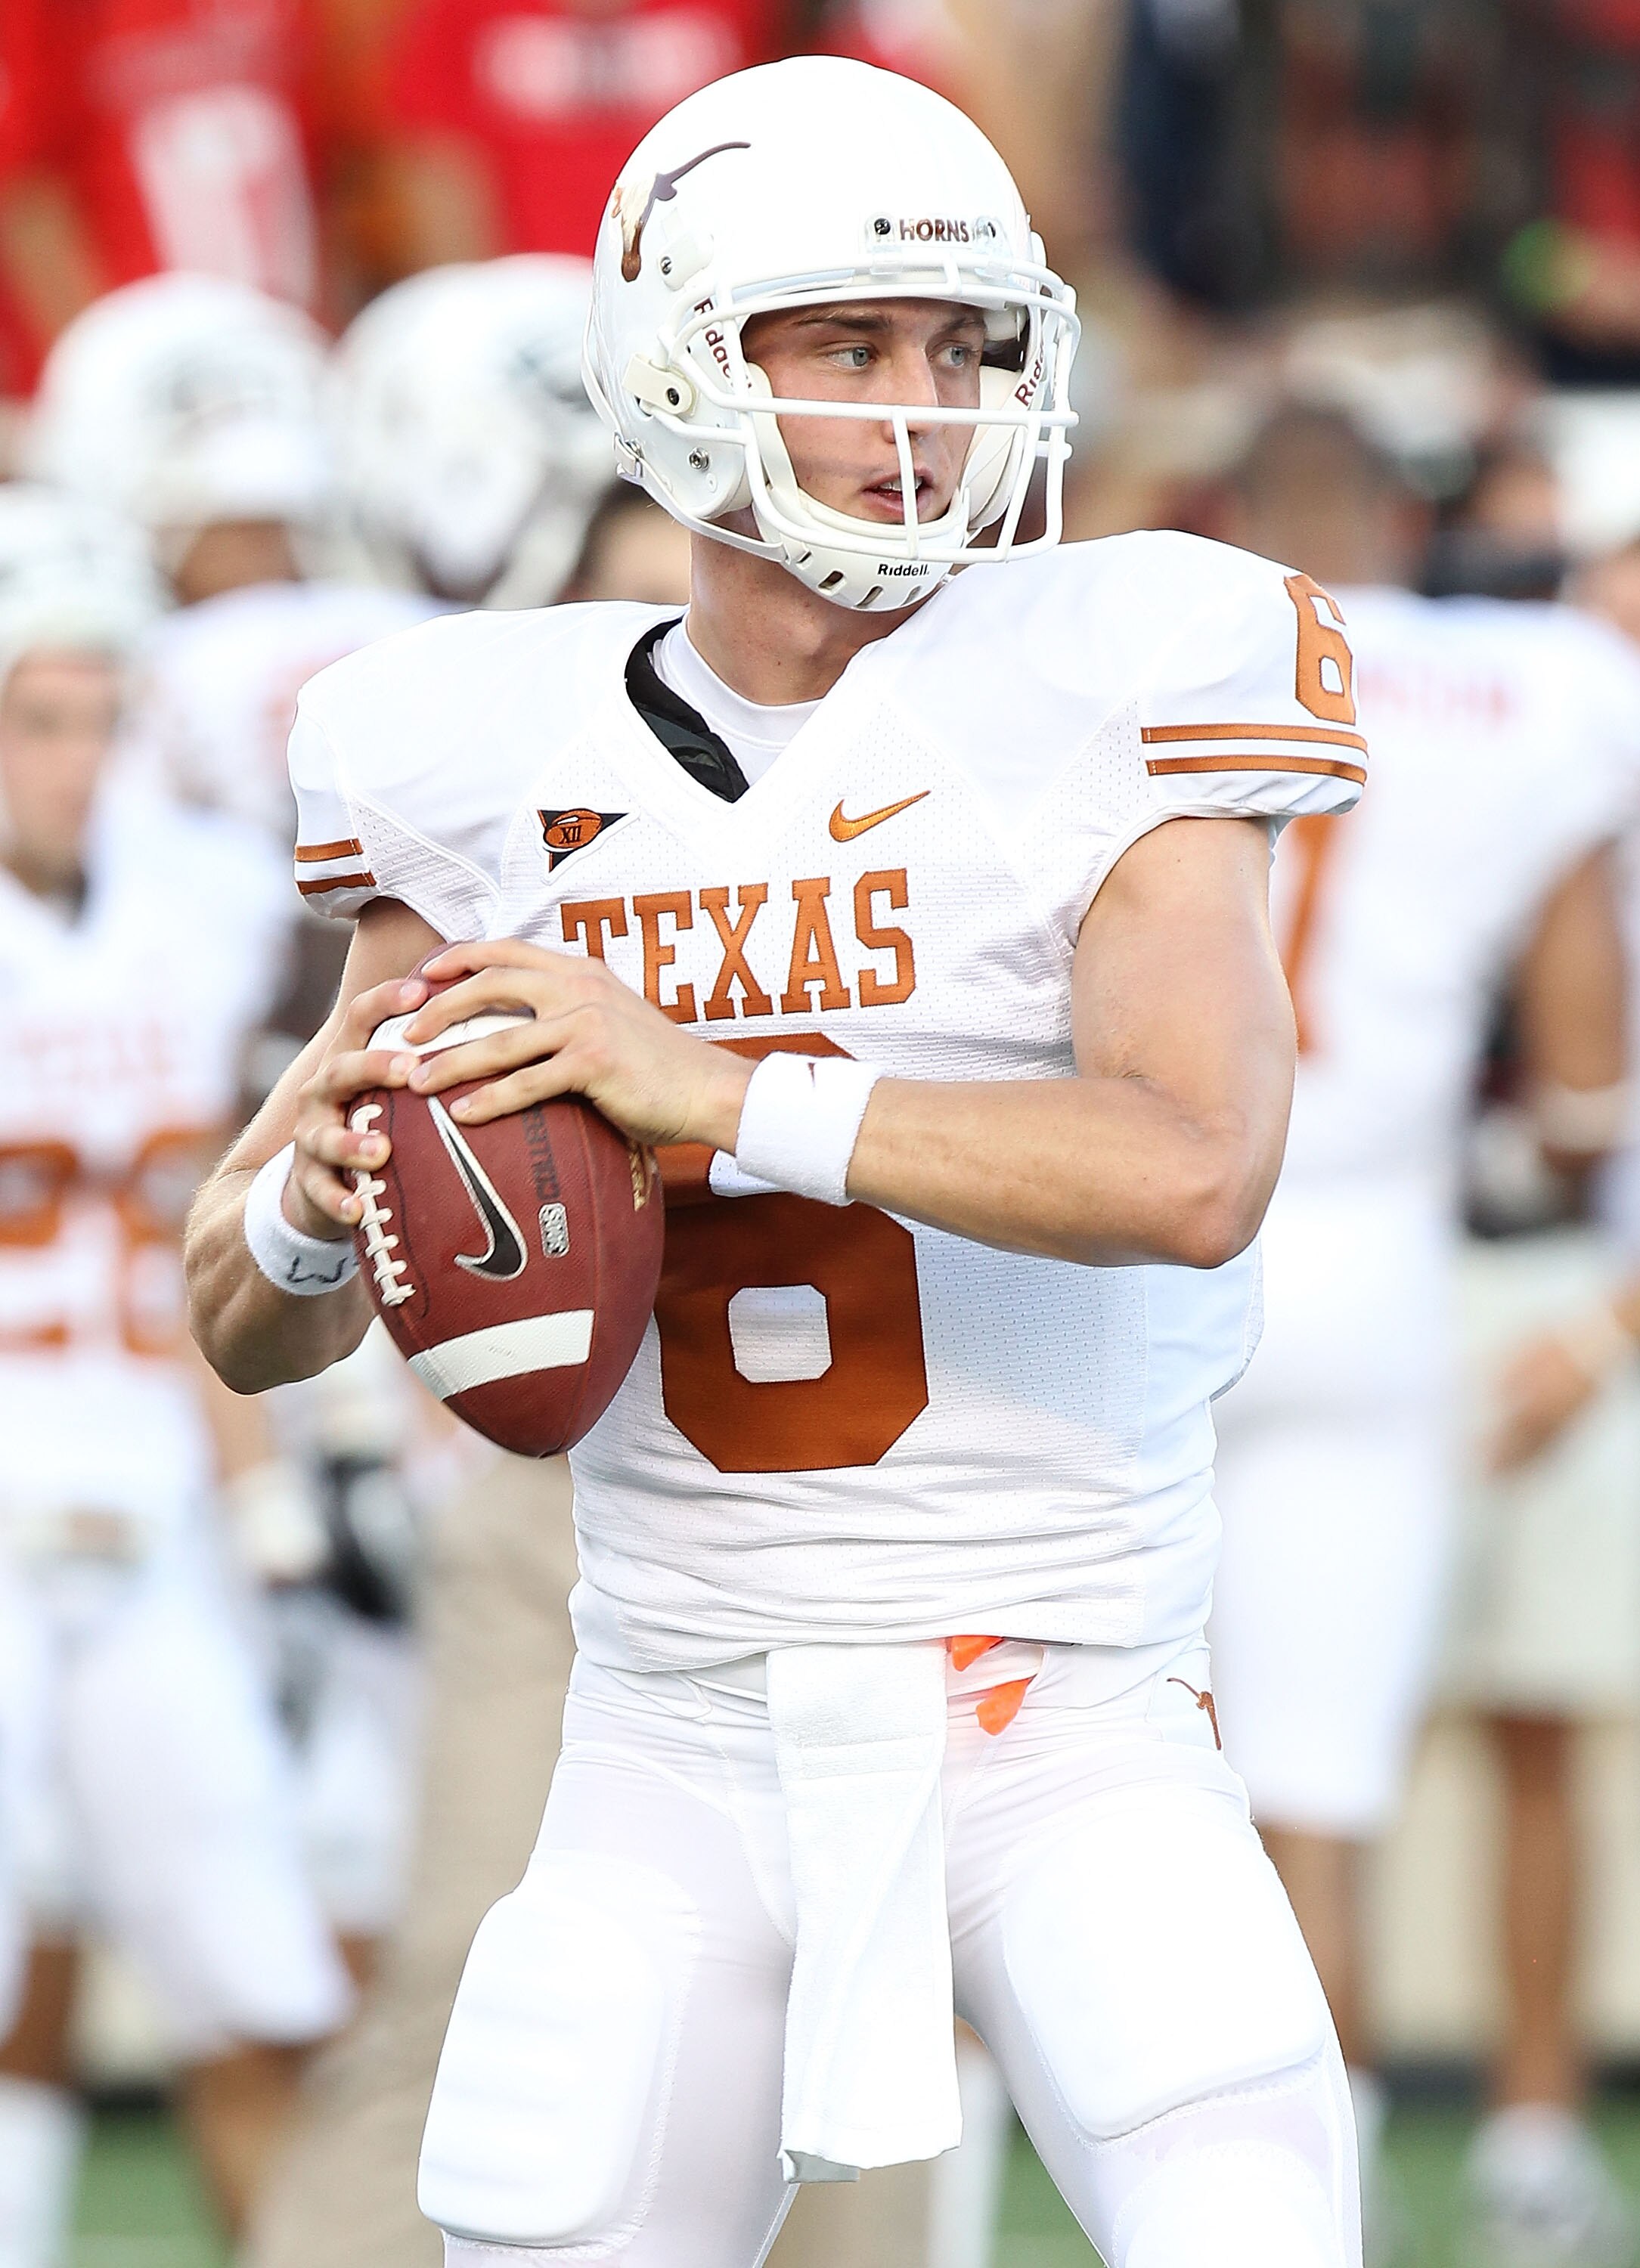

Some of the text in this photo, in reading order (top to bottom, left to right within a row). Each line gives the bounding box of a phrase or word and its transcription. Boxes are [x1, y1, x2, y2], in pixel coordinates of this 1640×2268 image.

[900, 218, 970, 243] HORNS
[877, 563, 929, 577] Riddell
[1283, 573, 1356, 726] 6
[559, 825, 581, 844] XII
[561, 868, 916, 1024] TEXAS
[655, 1031, 929, 1474] 6
